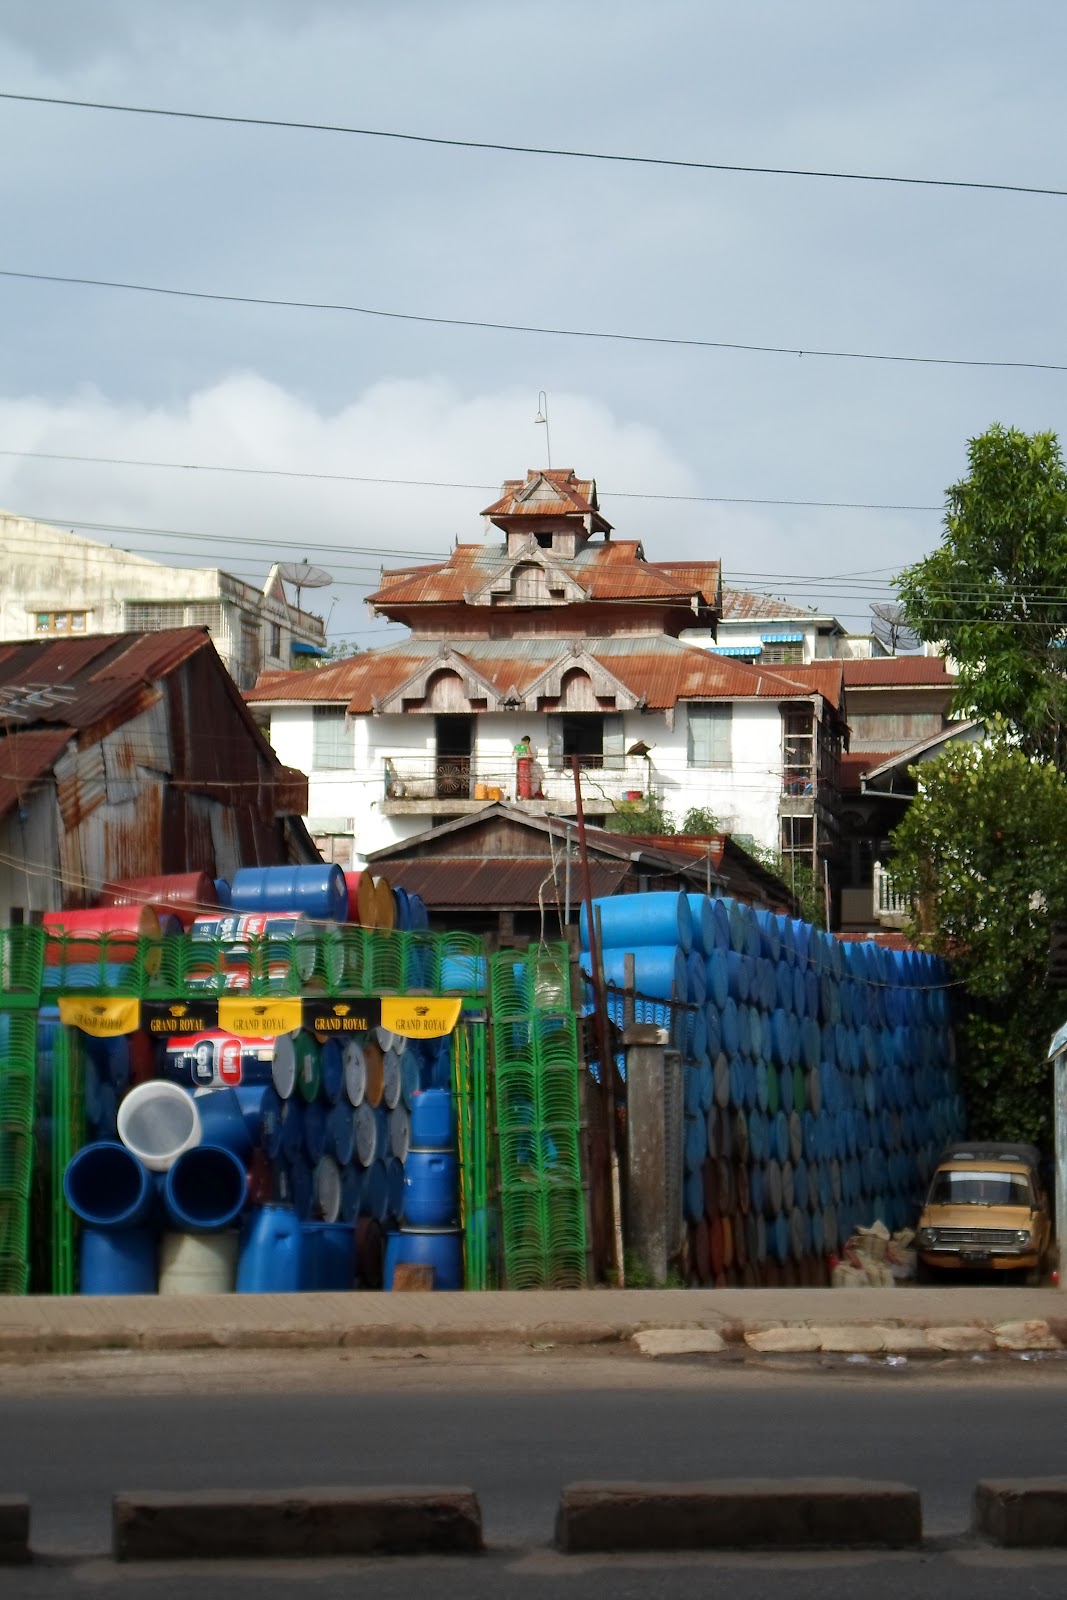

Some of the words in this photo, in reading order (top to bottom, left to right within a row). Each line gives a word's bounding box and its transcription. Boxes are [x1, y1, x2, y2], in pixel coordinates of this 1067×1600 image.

[150, 1018, 177, 1032] GRAND
[179, 1018, 205, 1031] ROYAL
[233, 1018, 259, 1031] GRAND
[262, 1018, 286, 1031] ROYAL
[314, 1018, 341, 1031] GRAND
[343, 1018, 368, 1031] ROYAL
[395, 1019, 421, 1031] GRAND
[423, 1019, 447, 1031] ROYAL
[196, 1045, 211, 1077] opal
